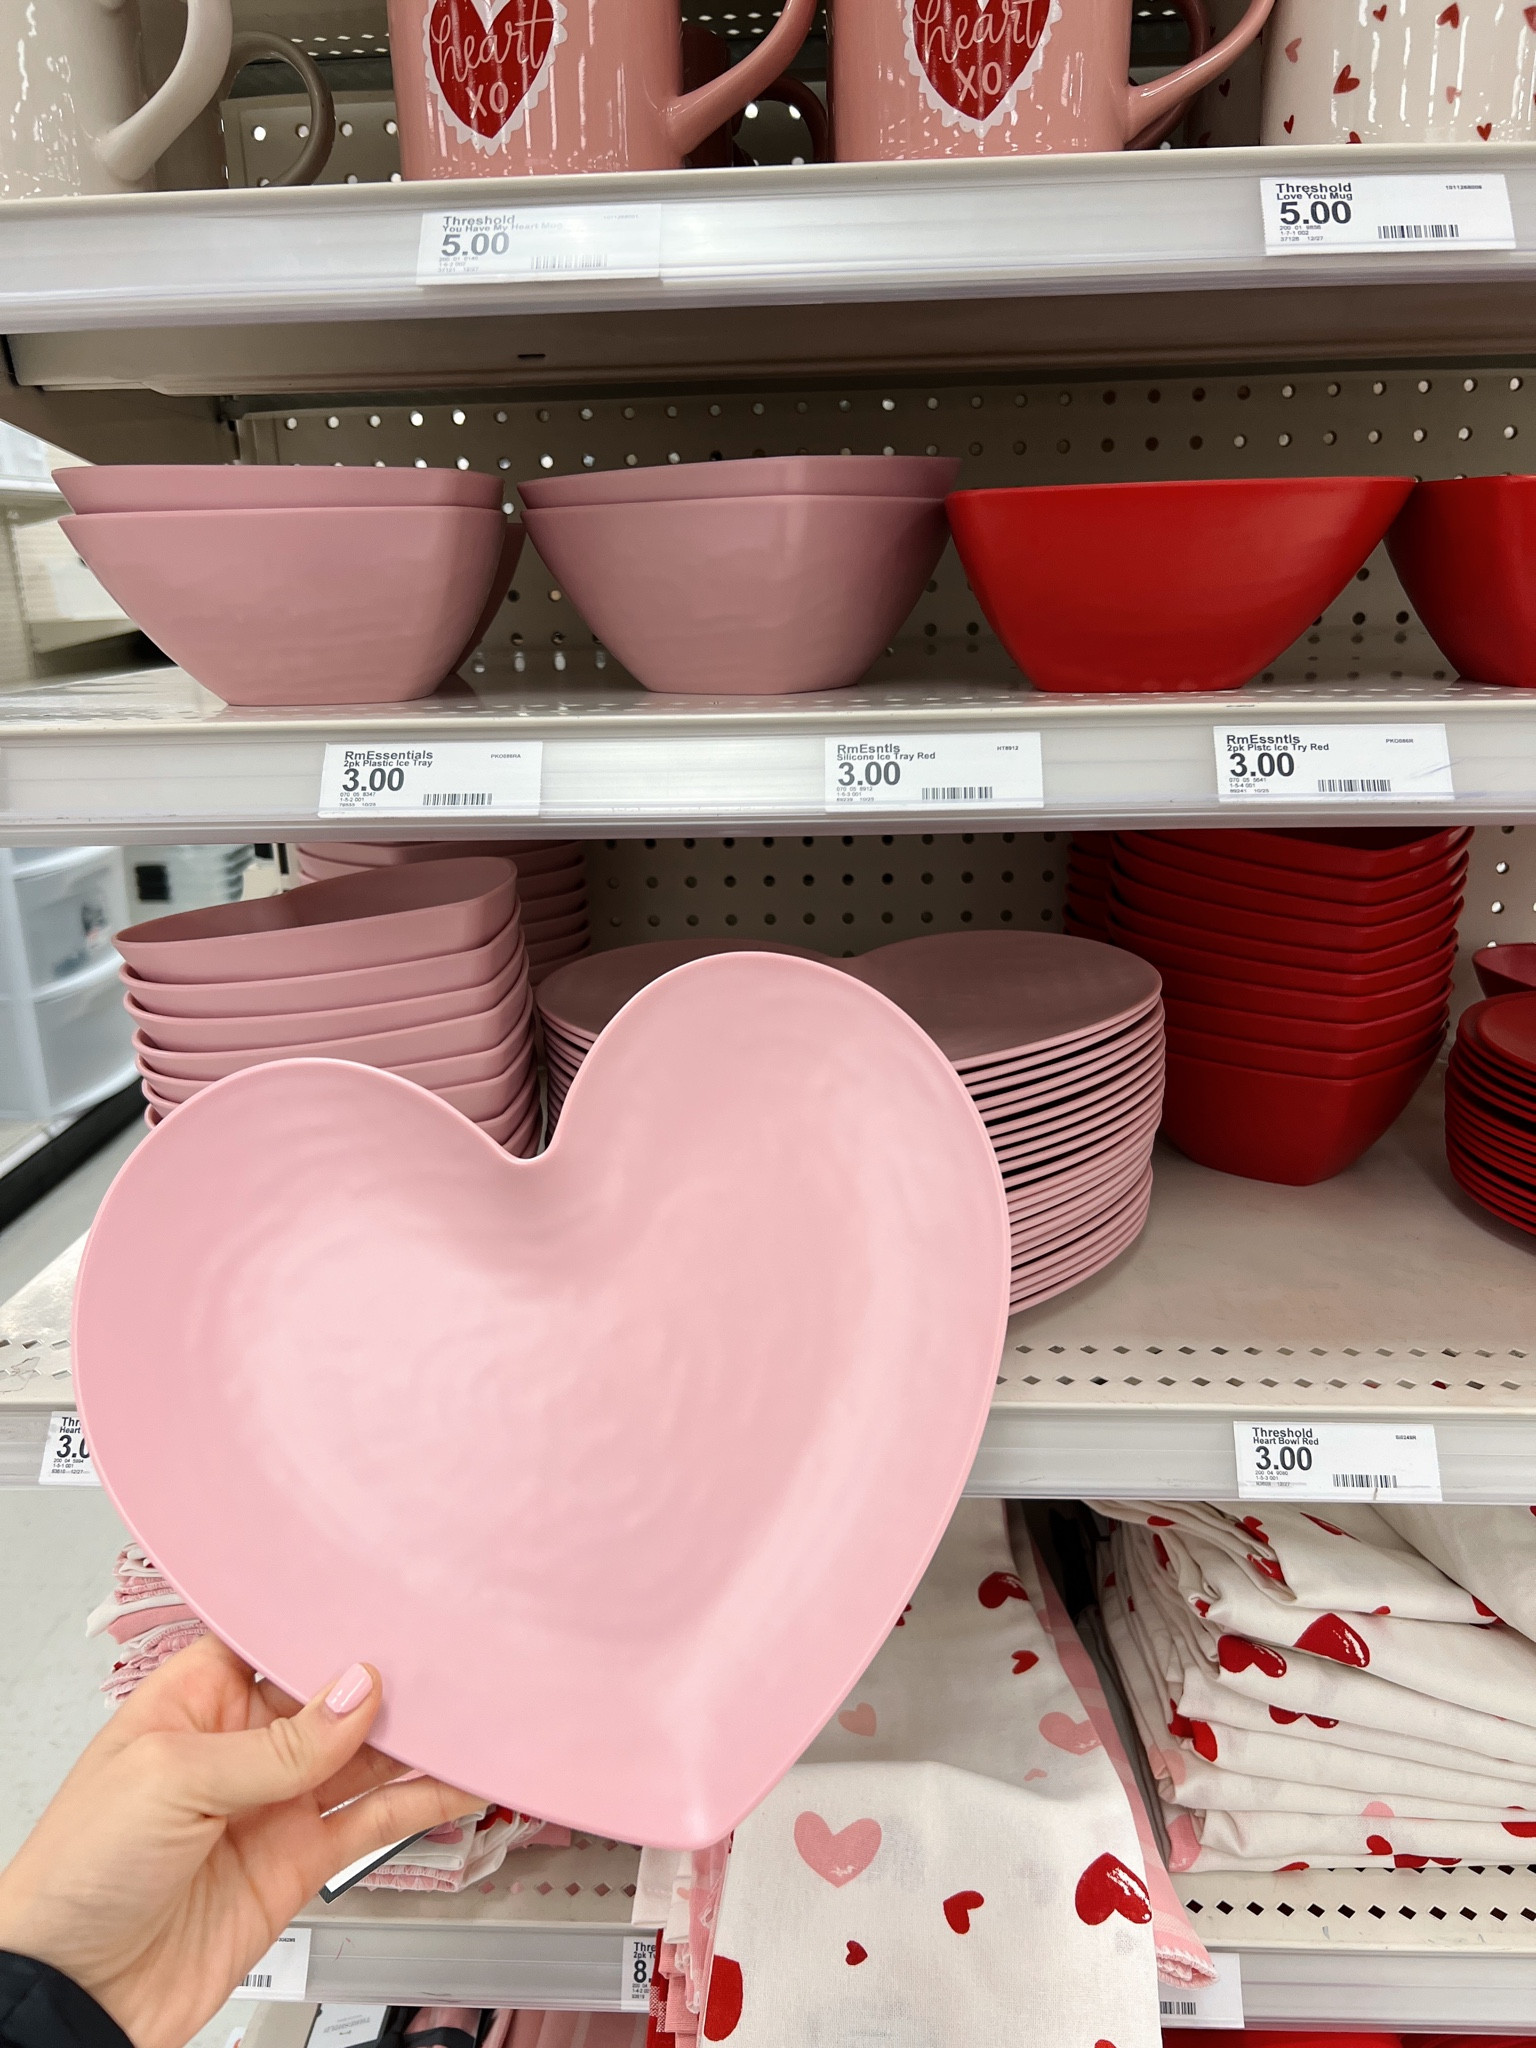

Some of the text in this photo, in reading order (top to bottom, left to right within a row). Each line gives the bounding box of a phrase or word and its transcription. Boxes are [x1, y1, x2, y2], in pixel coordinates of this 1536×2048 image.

[915, 0, 1040, 63] heart
[431, 0, 556, 82] heart
[1276, 183, 1351, 193] Threshold
[1306, 192, 1326, 200] You
[1330, 192, 1353, 201] Mug
[1280, 201, 1351, 225] 5.00
[443, 215, 515, 226] Threshold
[443, 225, 462, 233] You
[493, 224, 508, 232] My
[441, 232, 510, 256] 5.00
[1226, 734, 1301, 744] RmEssntls
[837, 744, 900, 753] RmEsntls
[1227, 744, 1245, 752] 2pk
[1274, 743, 1288, 751] Ice
[1291, 744, 1307, 752] Try
[345, 750, 433, 760] RmEssentials
[837, 753, 874, 761] Silicone
[894, 752, 914, 761] Tray
[344, 760, 360, 768] 2pk
[413, 760, 433, 768] Tray
[1230, 752, 1295, 777] 3.00
[838, 761, 901, 786] 3.00
[342, 768, 404, 791] 3.00
[61, 1417, 82, 1427] Thr
[1252, 1427, 1313, 1438] Threshold
[56, 1435, 90, 1458] 3.0
[1255, 1446, 1312, 1471] 3.00
[633, 1941, 656, 1951] Thre
[633, 1951, 646, 1960] 2pk
[633, 1960, 652, 1983] 8.
